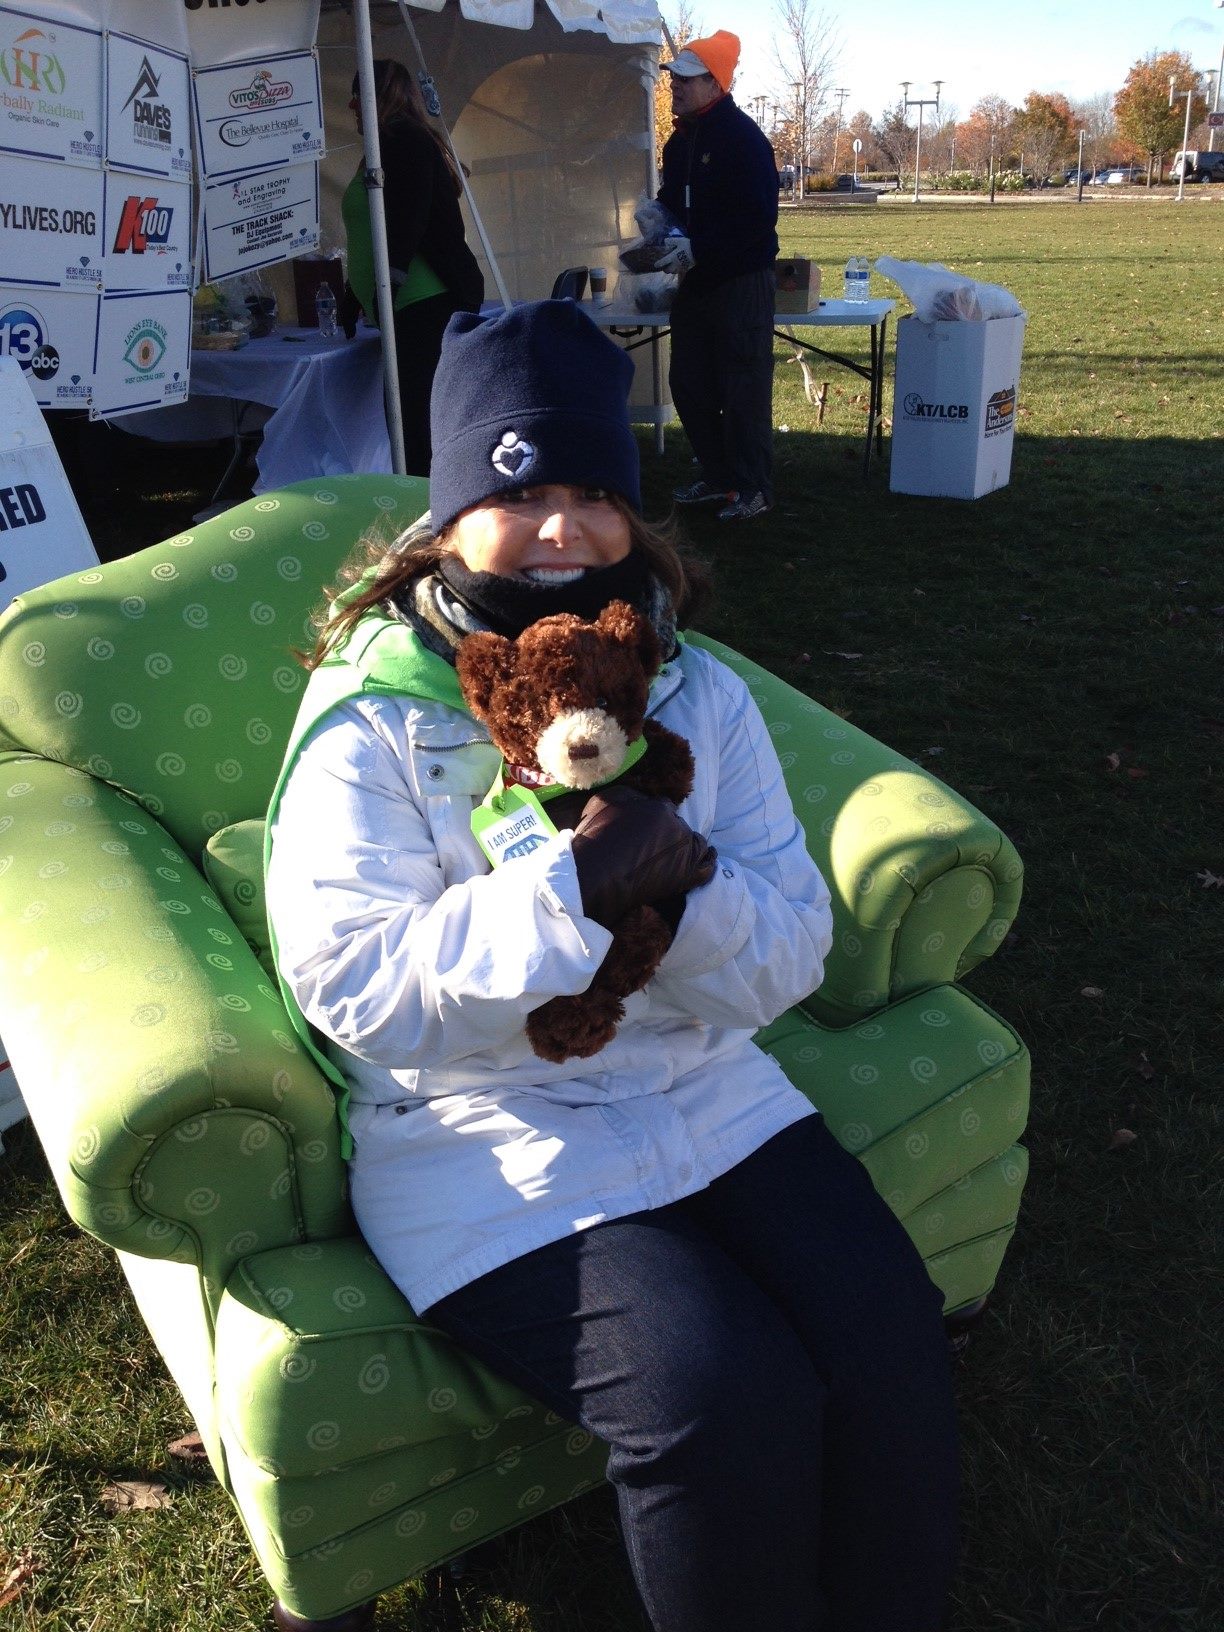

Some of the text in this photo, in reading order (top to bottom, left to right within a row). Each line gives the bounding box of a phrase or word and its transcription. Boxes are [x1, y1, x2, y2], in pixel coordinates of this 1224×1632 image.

[232, 91, 259, 104] VITO'S
[38, 99, 85, 121] Radiant
[134, 99, 171, 130] DAVE'S
[45, 119, 60, 128] Care
[226, 115, 299, 138] The Bellevue Hospital
[250, 183, 266, 195] STAR
[267, 177, 291, 190] TROPHY
[238, 195, 251, 206] and
[253, 187, 286, 202] Engraving
[232, 209, 294, 236] THE TRACK SHACK:
[246, 229, 254, 239] DJ
[124, 322, 141, 345] LIONS
[153, 321, 168, 340] BANK
[31, 352, 59, 369] abc
[916, 403, 969, 419] KT/LCB
[487, 814, 537, 851] I AM SUPER!
